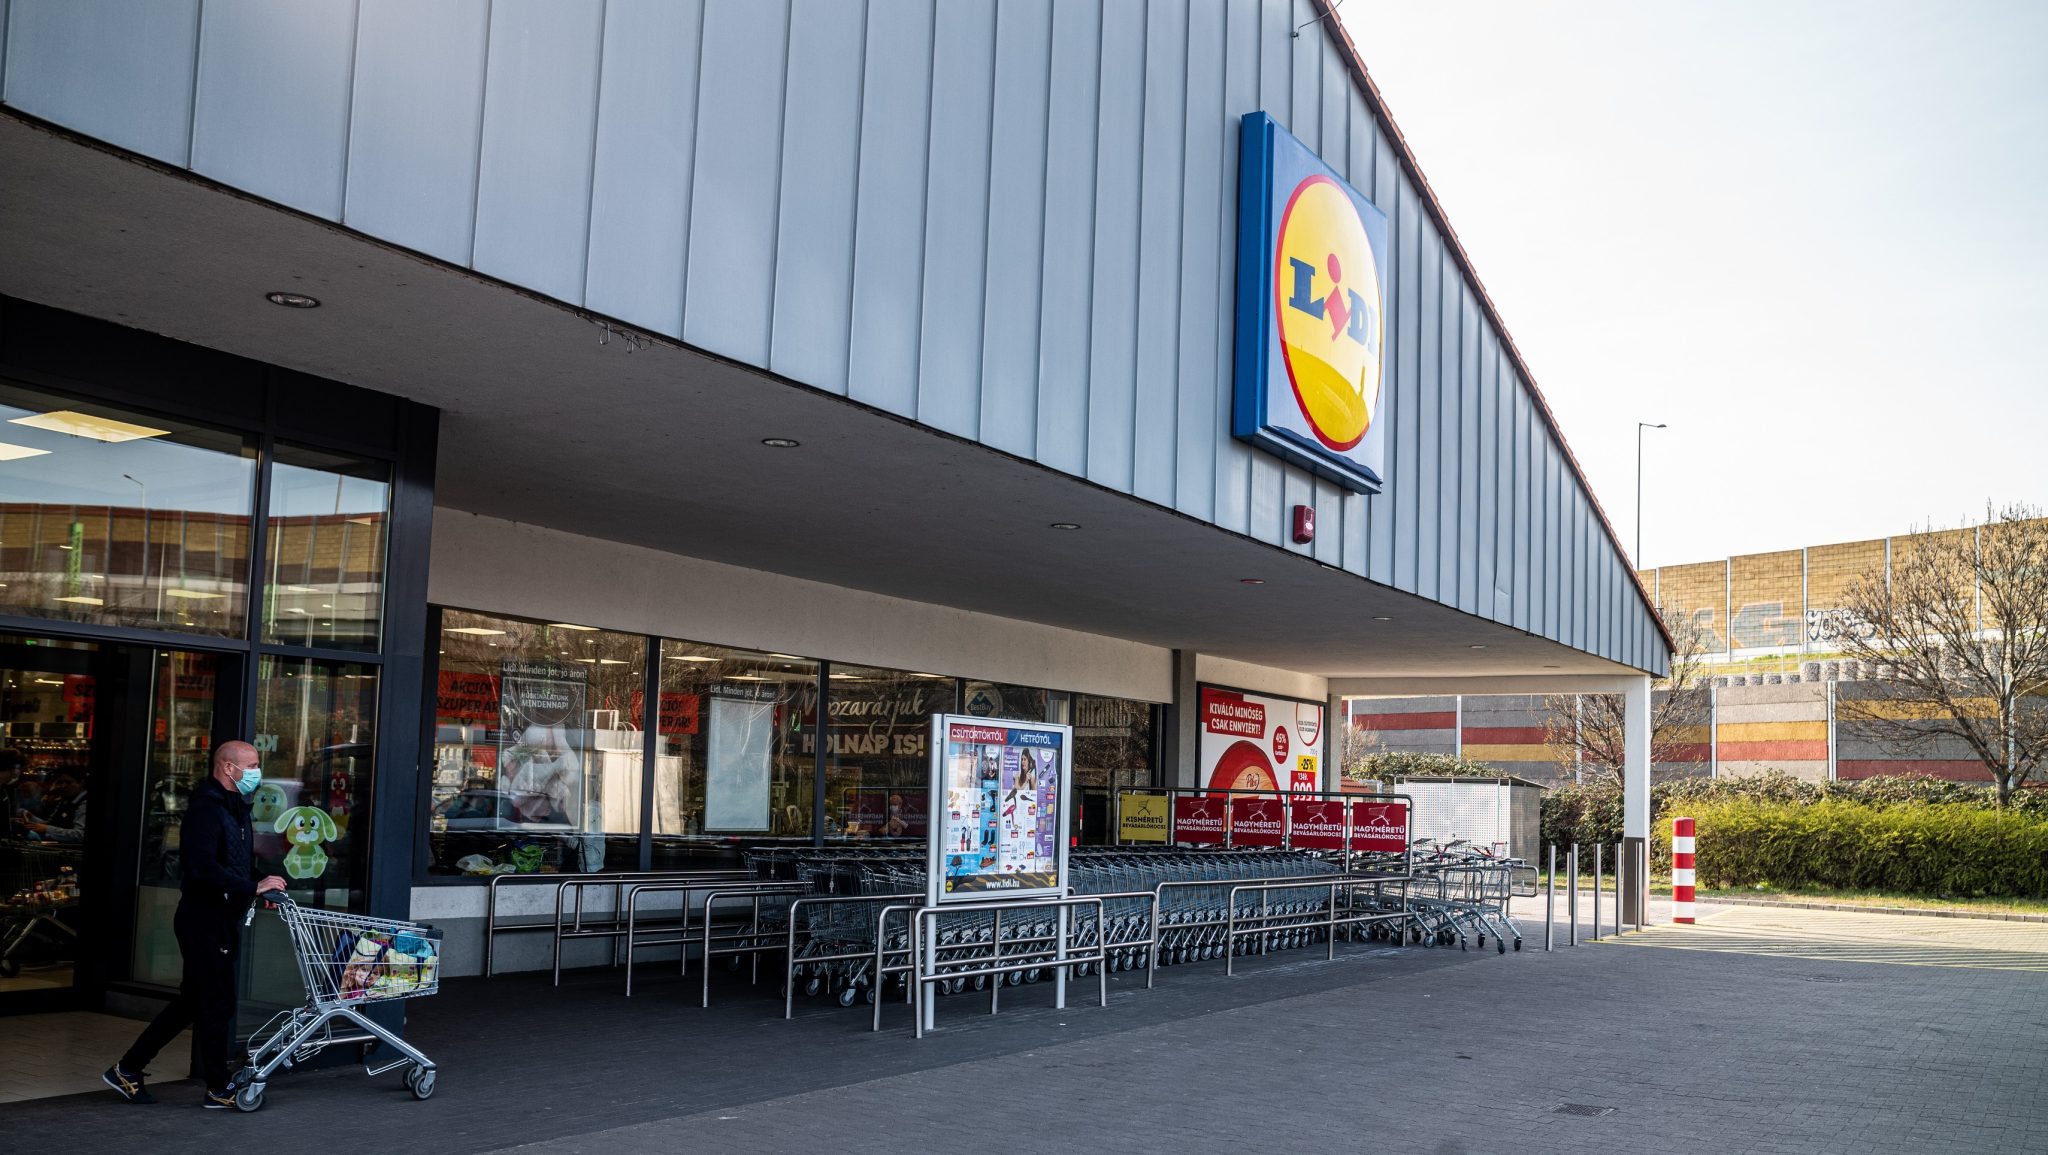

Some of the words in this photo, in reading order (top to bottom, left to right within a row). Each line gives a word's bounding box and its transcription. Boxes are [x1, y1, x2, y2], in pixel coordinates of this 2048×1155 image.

[520, 664, 546, 675] Minden
[569, 669, 587, 679] áron!
[723, 686, 744, 696] Minden
[521, 699, 569, 710] MINDENNAP!
[1209, 702, 1234, 716] KIVÁLÓ
[1234, 705, 1263, 721] MINŐSÉG
[1211, 718, 1229, 730] CSAK
[1229, 720, 1261, 735] ENNYIÉRT!
[951, 728, 1003, 741] CSÜTÖRTÖKTŐL
[1020, 732, 1052, 745] HÉTFŐTŐL
[892, 734, 925, 757] IS!
[1125, 815, 1163, 824] KISMÉRETŰ
[1176, 817, 1223, 826] NAGYMÉRETŰ
[1233, 819, 1281, 829] NAGYMÉRETŰ
[1122, 822, 1166, 830] BEVÁSÁRLÓKOCSI
[1176, 824, 1223, 832] BEVÁSÁRLÓKOCSI
[1293, 822, 1342, 831] NAGYMÉRETŰ
[1353, 825, 1405, 834] NAGYMÉRETŰ
[1233, 827, 1281, 835] BEVÁSÁRLÓKOCSI
[1292, 829, 1342, 838] BEVÁSÁRLÓKOCSI
[1353, 832, 1405, 841] BEVÁSÁRLÓKOCSI
[985, 879, 1020, 890] www.lidl.hu
